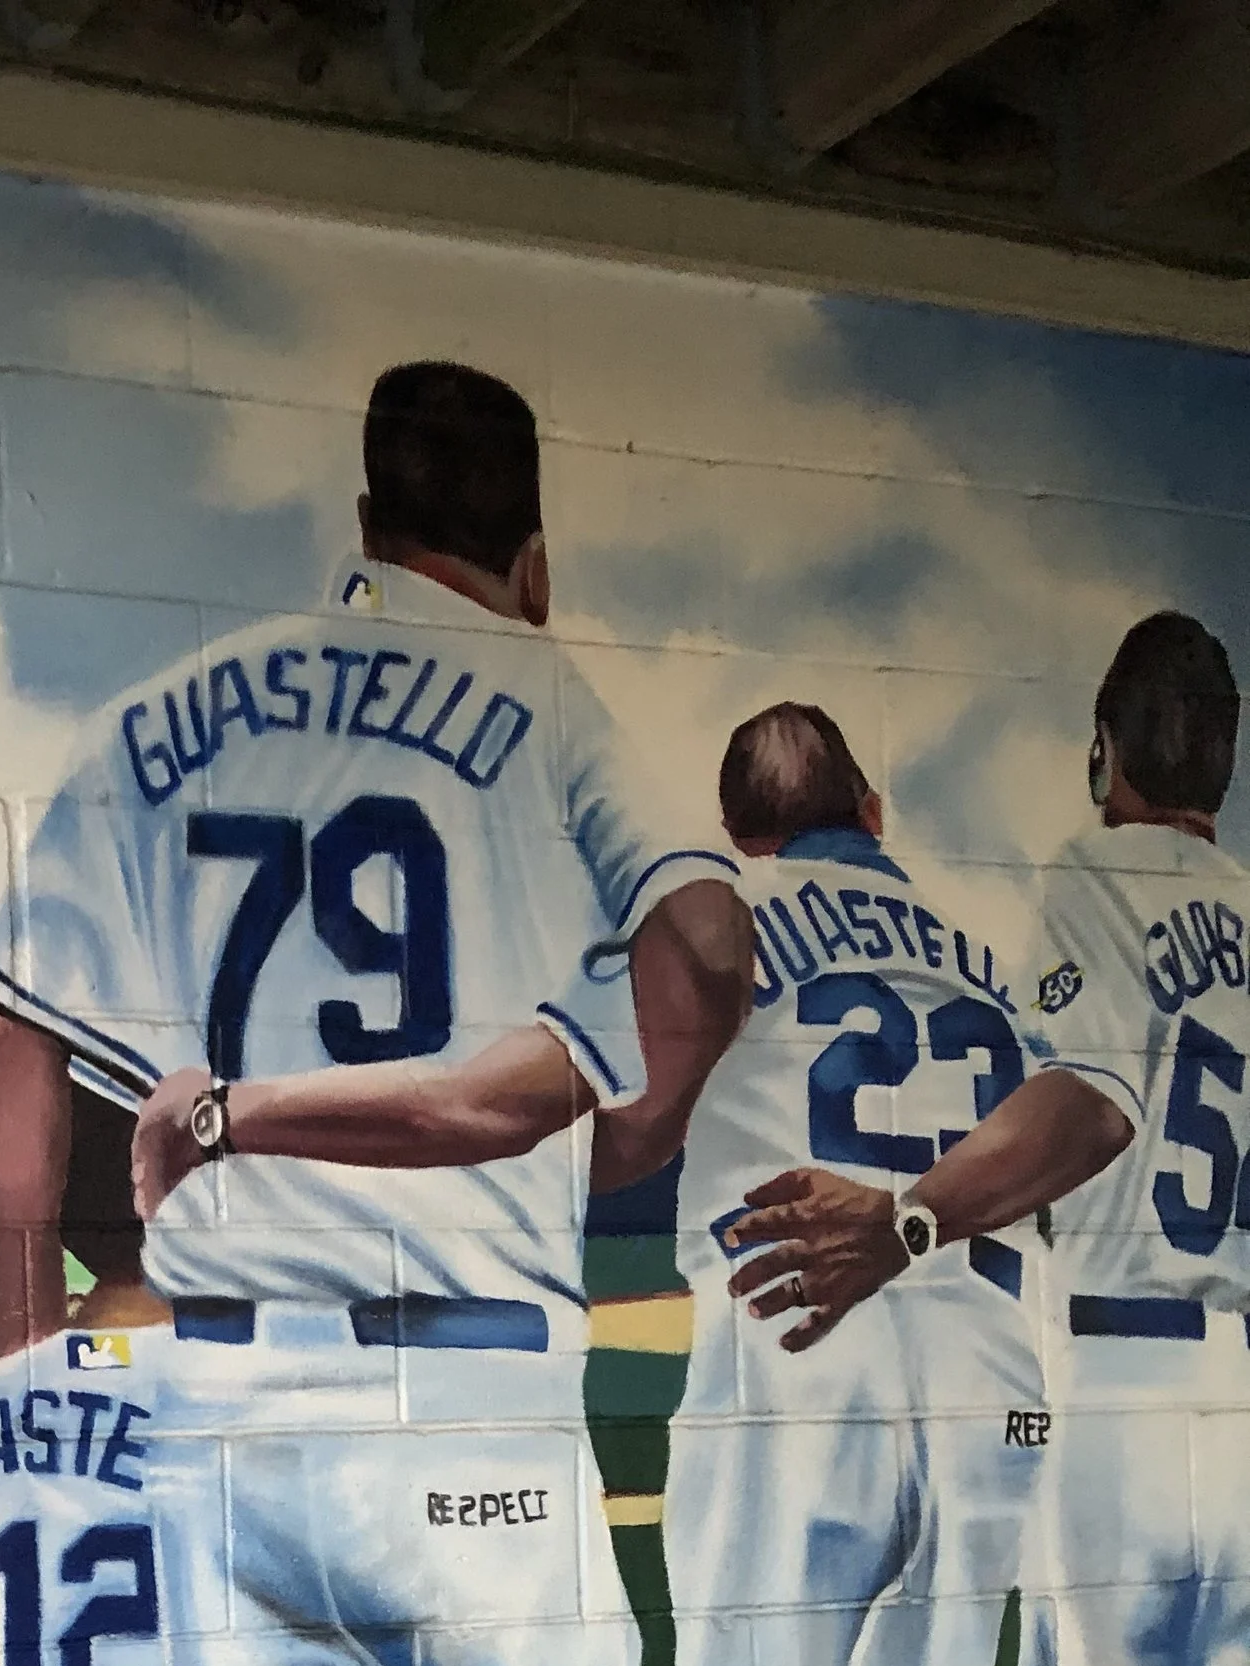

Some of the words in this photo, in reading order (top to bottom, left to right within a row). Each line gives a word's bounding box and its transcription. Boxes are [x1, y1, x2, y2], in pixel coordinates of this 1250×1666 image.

[121, 645, 534, 806] GUASTELLO
[186, 796, 454, 1083] 79
[796, 970, 1025, 1174] 23
[1153, 1013, 1250, 1256] 5
